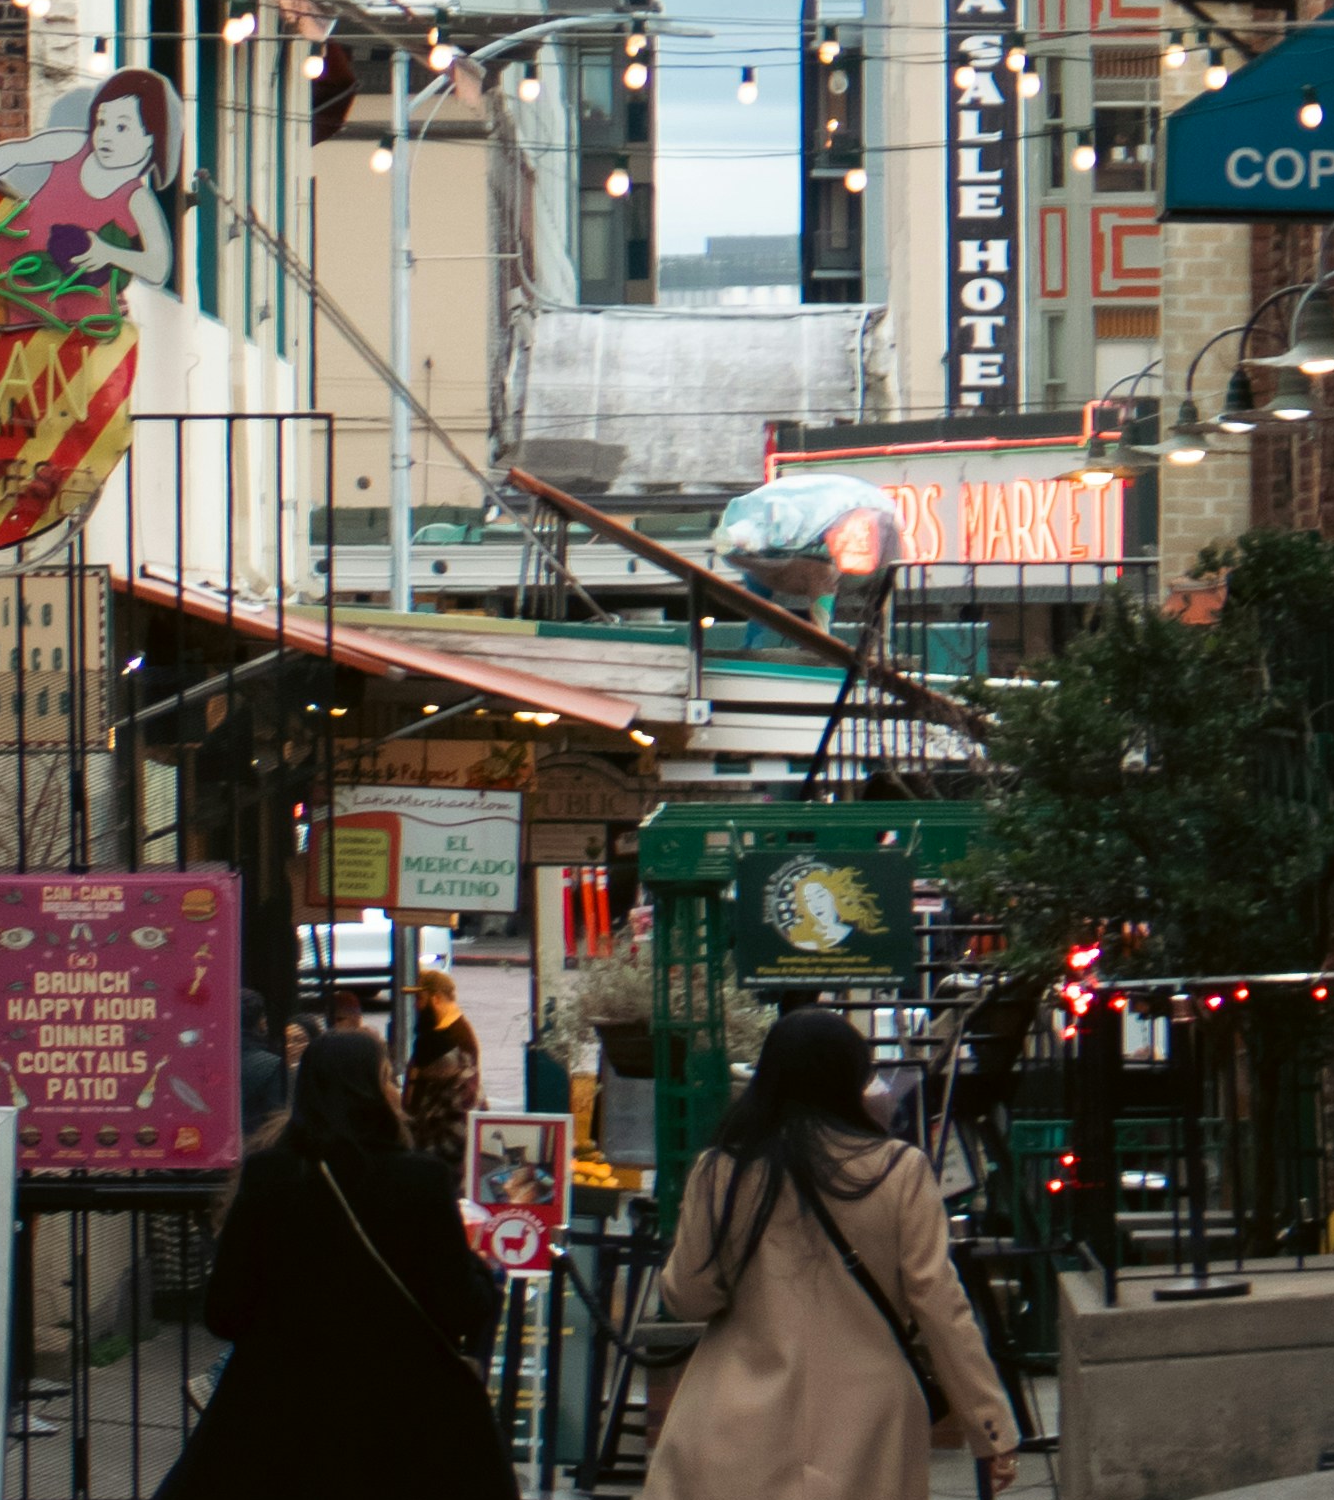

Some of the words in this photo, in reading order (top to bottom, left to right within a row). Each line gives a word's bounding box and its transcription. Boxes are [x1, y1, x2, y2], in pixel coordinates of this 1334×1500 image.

[956, 34, 1005, 219] SALLE
[880, 483, 943, 562] RS
[962, 477, 1114, 562] MARKET
[445, 834, 474, 852] EL
[404, 858, 517, 878] MERCADO
[417, 880, 500, 898] LATINO
[33, 970, 130, 995] BRUNCH
[6, 997, 87, 1021] HAPPY
[92, 997, 157, 1021] HOUR
[39, 1023, 126, 1048] DINNER
[17, 1050, 149, 1075] COCKTAILS
[46, 1077, 118, 1101] PATIO
